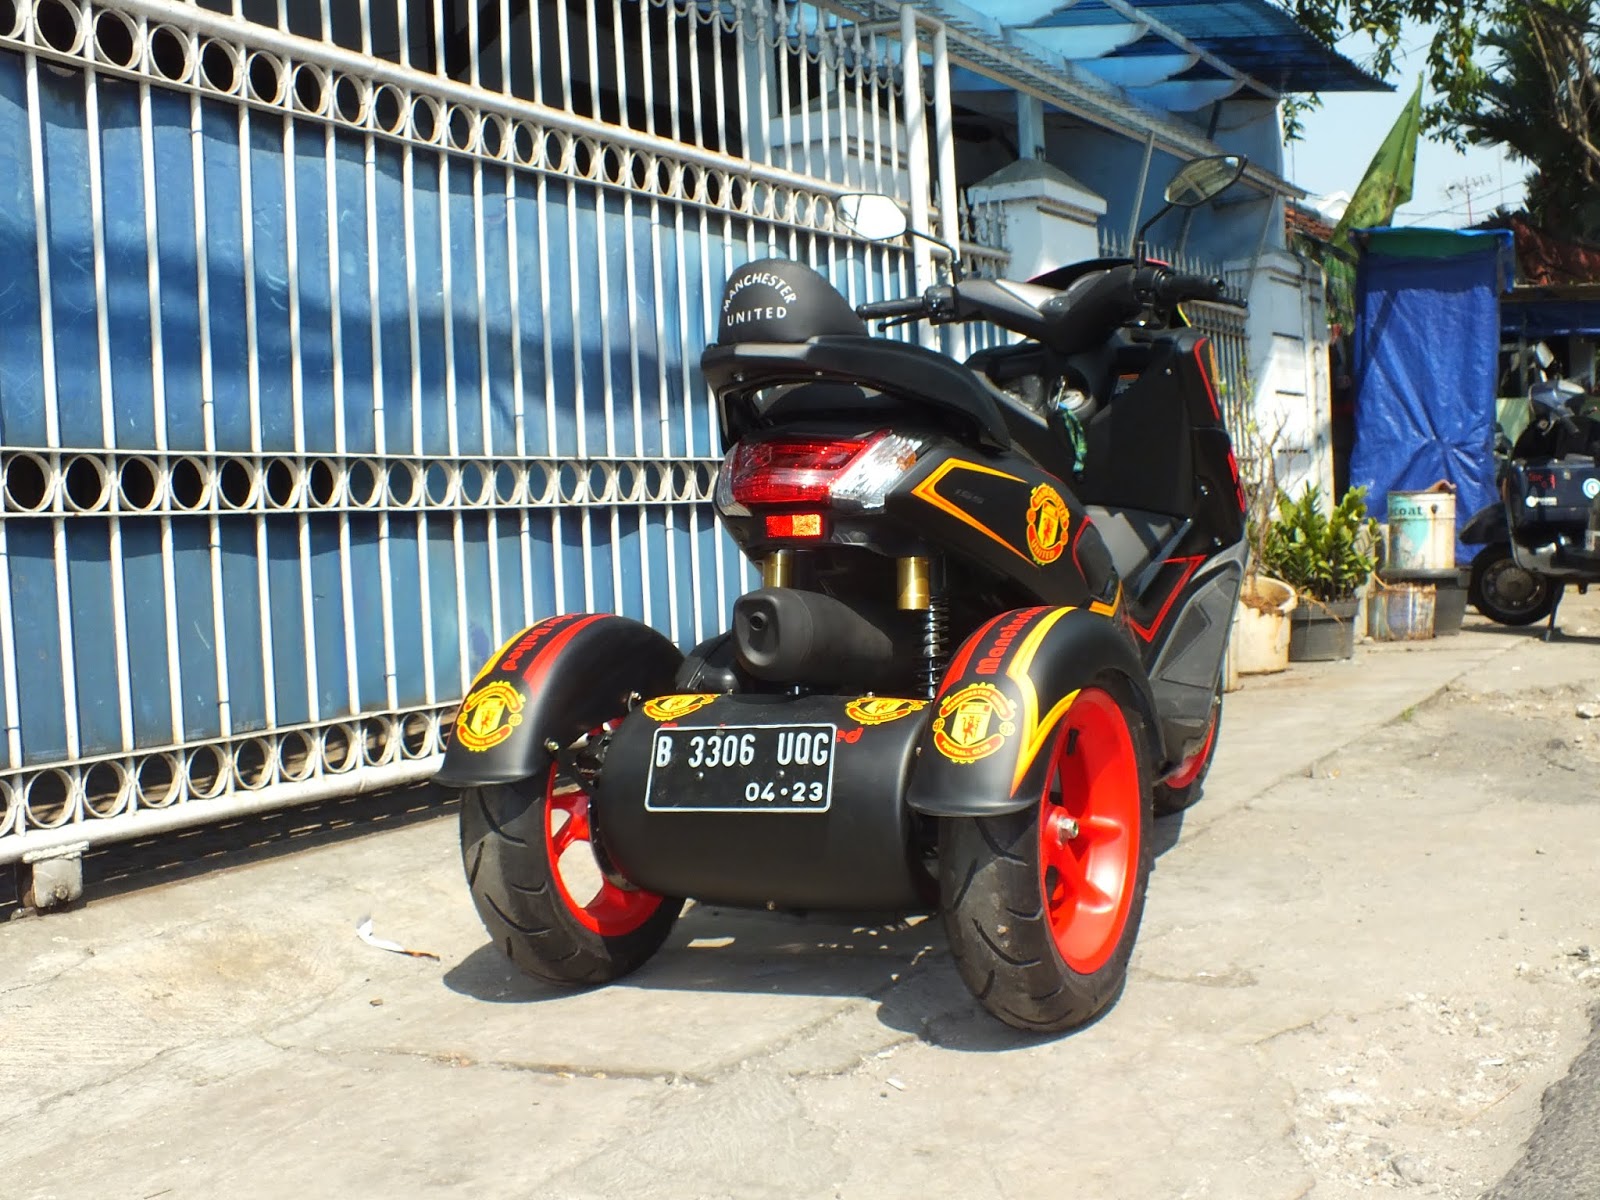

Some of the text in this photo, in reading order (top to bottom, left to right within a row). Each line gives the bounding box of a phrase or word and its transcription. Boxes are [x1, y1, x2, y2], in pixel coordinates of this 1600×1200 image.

[723, 272, 797, 312] MANCHESTER
[727, 306, 788, 327] UNITED
[655, 735, 673, 768] B
[688, 733, 756, 768] 3306
[777, 732, 829, 766] UQG
